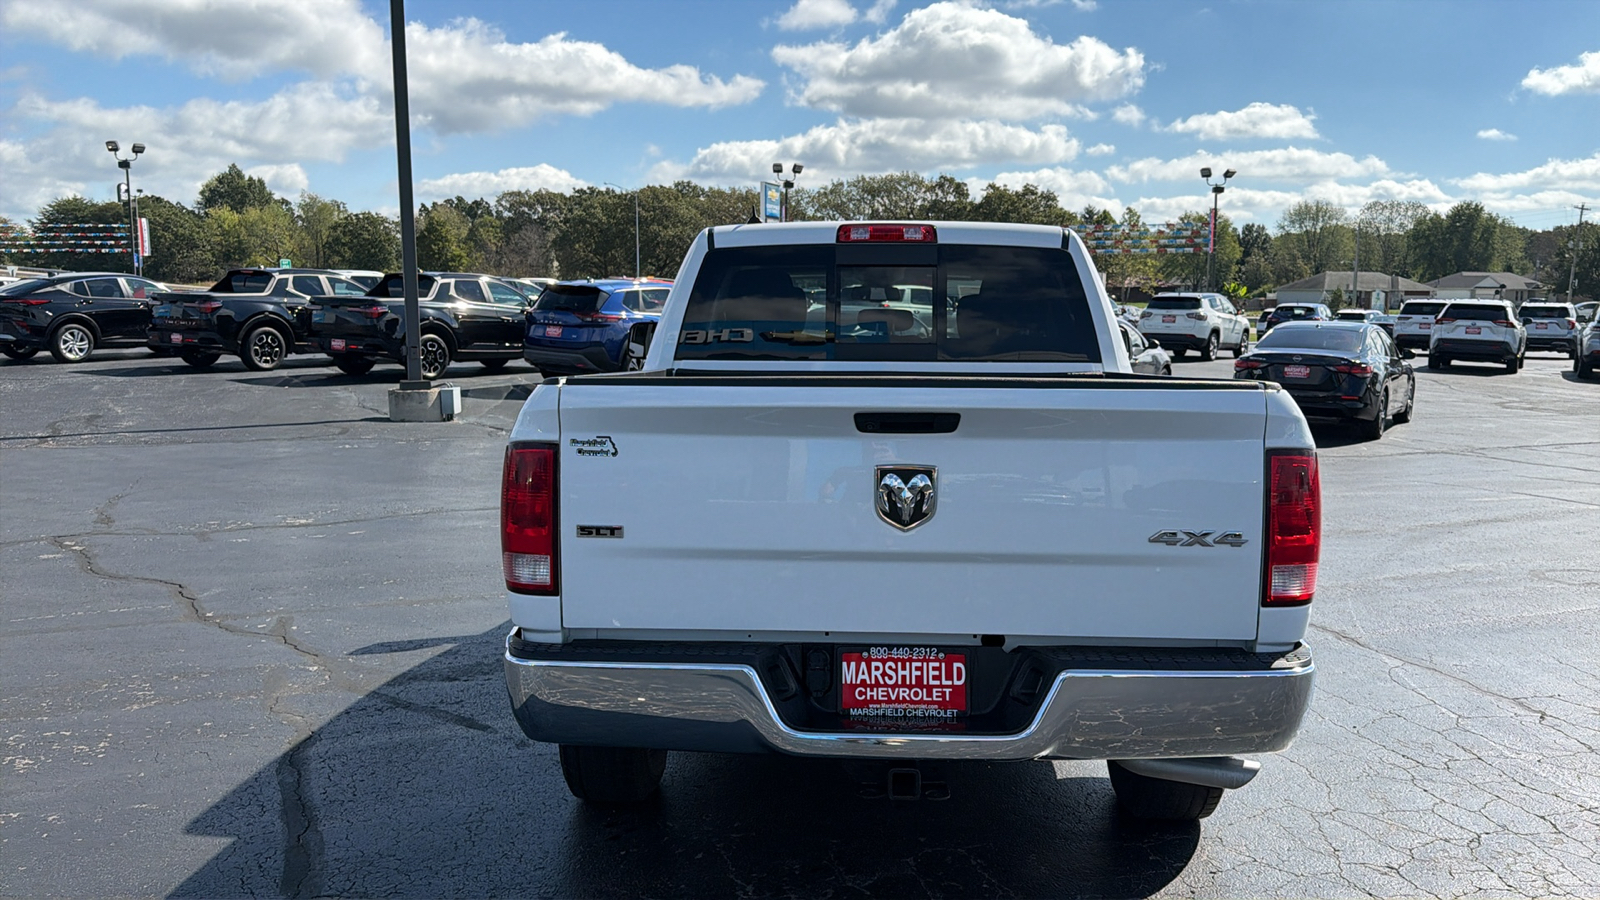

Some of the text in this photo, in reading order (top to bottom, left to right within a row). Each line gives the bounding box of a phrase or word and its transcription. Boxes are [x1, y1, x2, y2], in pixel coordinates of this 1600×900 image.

[578, 526, 622, 536] SLT
[869, 647, 938, 657] 800-440-2312
[842, 661, 966, 685] MARSHFIELD
[854, 687, 953, 701] CHEVROLET
[850, 708, 958, 718] MARSHFIELD CHEVROLET
